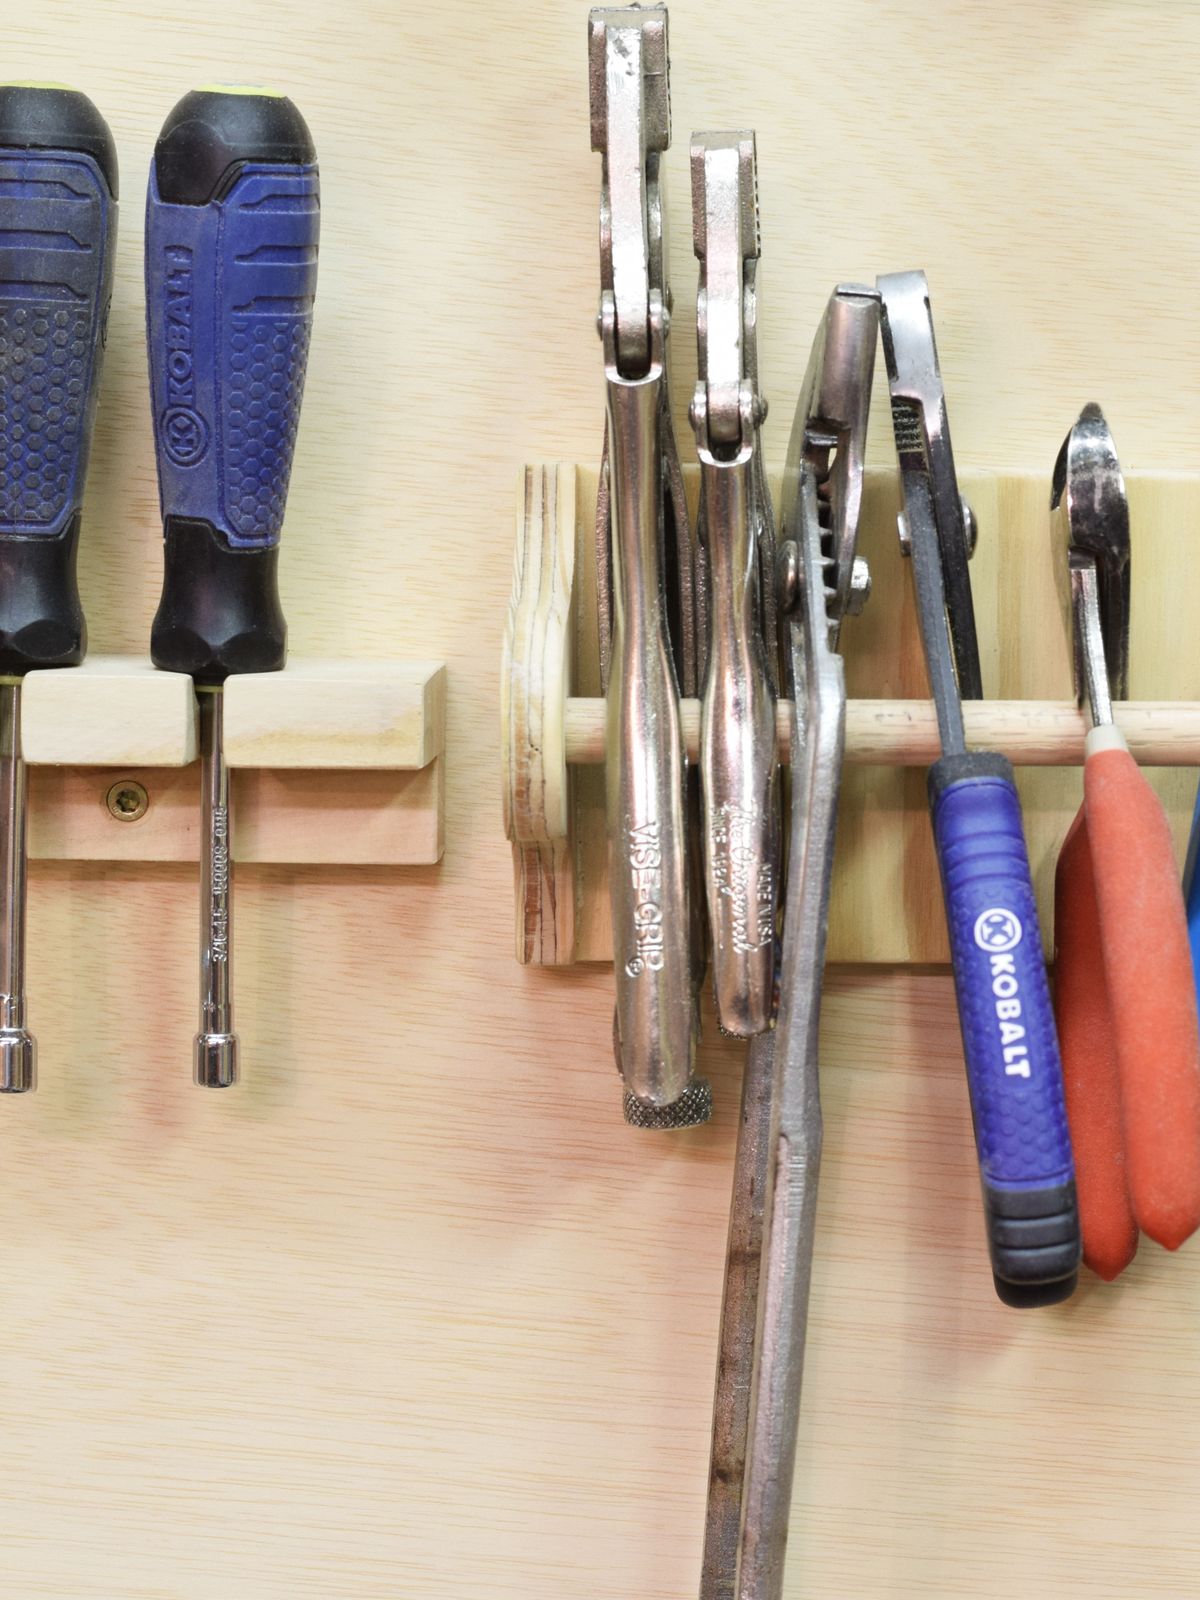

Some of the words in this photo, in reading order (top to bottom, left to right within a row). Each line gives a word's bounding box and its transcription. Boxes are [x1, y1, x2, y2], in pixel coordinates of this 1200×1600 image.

[164, 244, 194, 406] KOBALT
[629, 821, 665, 971] VISE-GRIP
[989, 953, 1031, 1078] KOBALT
